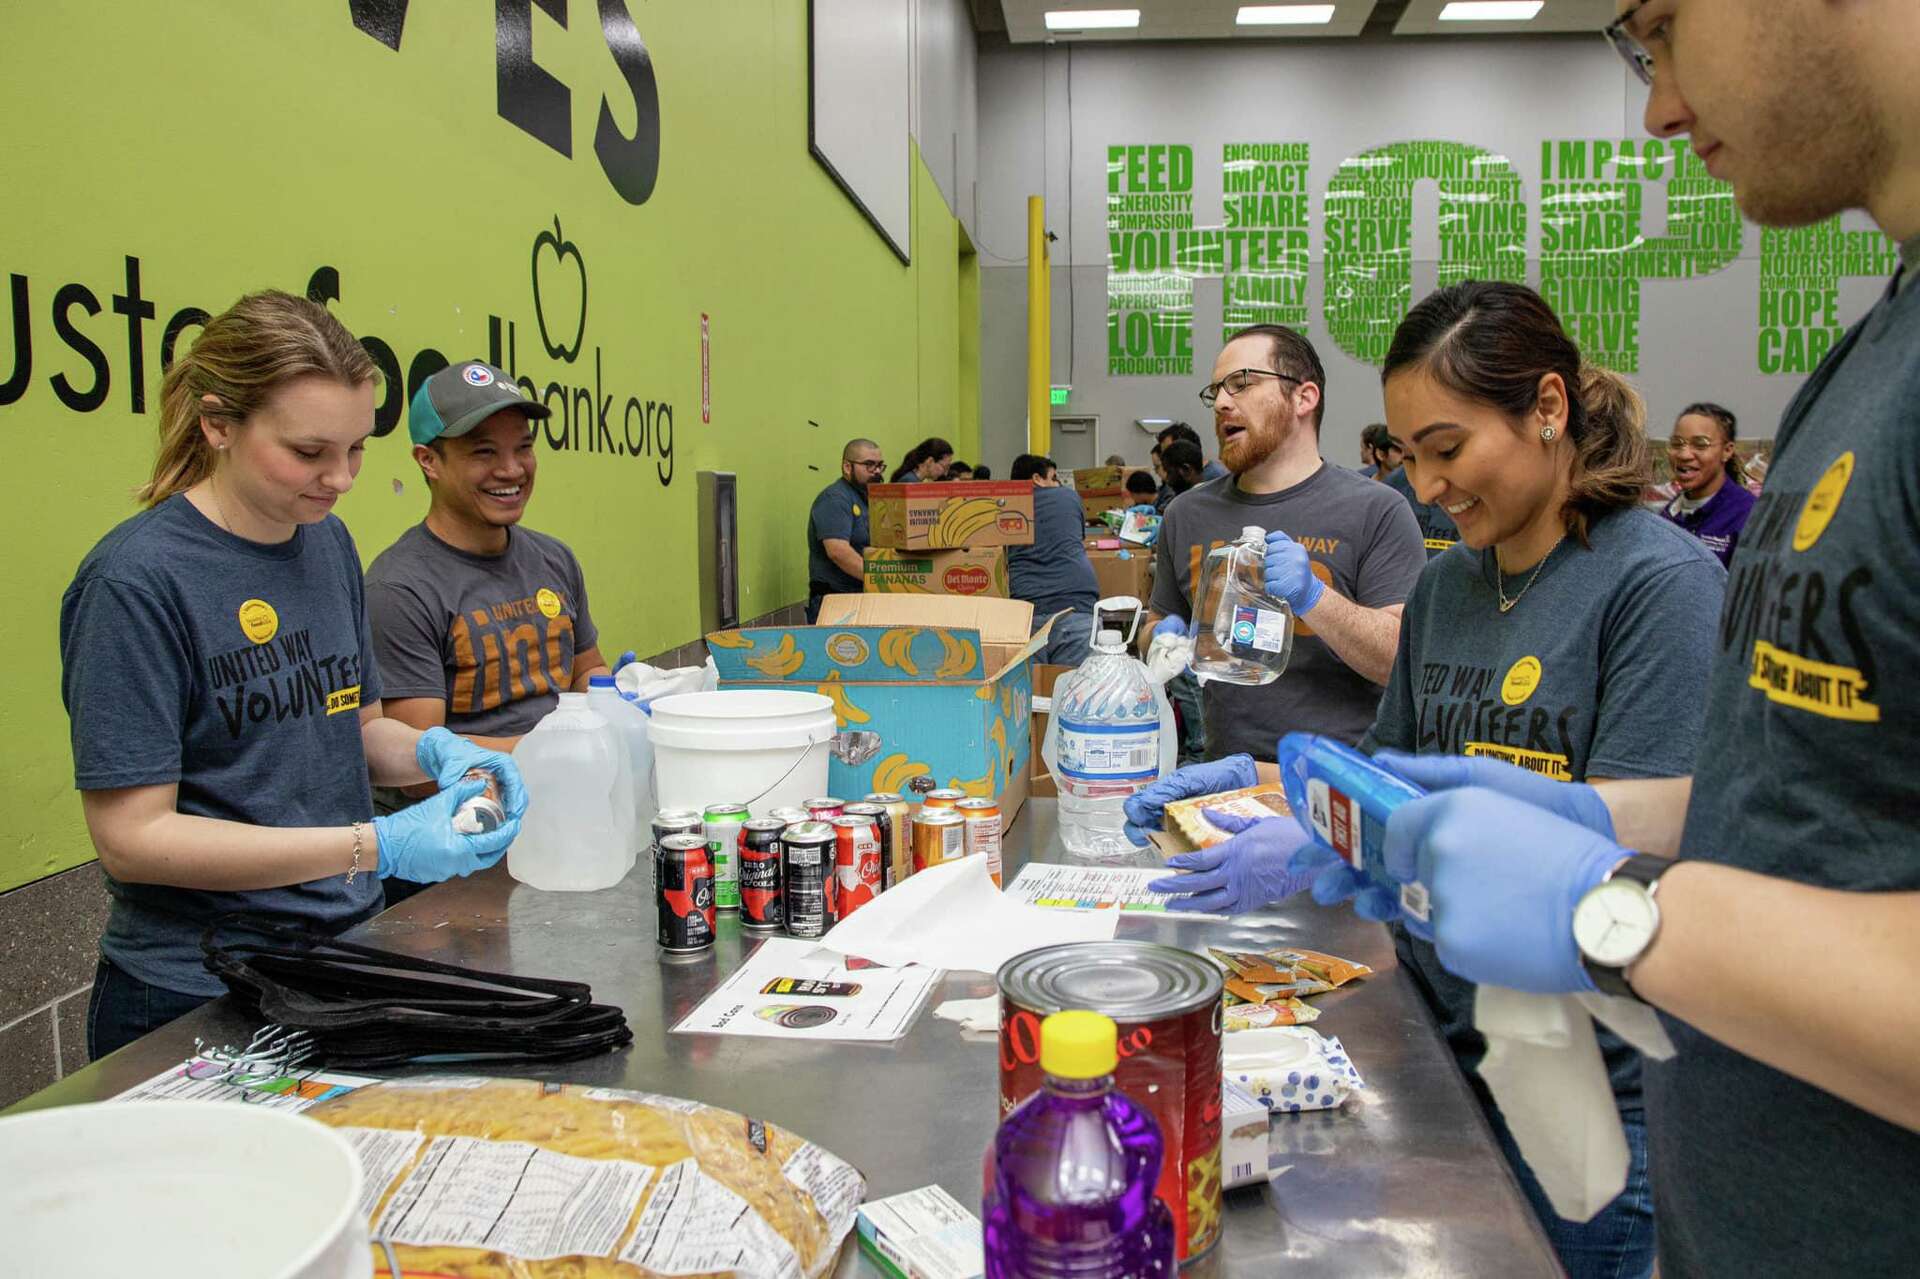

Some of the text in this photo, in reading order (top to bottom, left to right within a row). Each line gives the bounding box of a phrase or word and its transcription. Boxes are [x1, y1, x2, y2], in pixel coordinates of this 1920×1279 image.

[1223, 144, 1309, 162] ENCOURAGE
[1357, 152, 1489, 180] COMMUNITY
[1541, 140, 1689, 179] IMPACT
[1108, 145, 1193, 192] FEED
[1223, 165, 1309, 193] IMPACT
[1328, 180, 1413, 198] GENEROSITY
[1439, 180, 1521, 201] SUPPORT
[1540, 183, 1641, 212] BLESSED
[1668, 178, 1735, 197] OUTREAC
[1108, 194, 1193, 212] GENEROSITY
[1223, 194, 1309, 228] SHARE
[1324, 198, 1412, 218] OUTREACH
[1108, 213, 1193, 230] COMPASSION
[1439, 202, 1527, 233] GIVING
[1324, 218, 1412, 253] SERVE
[1540, 212, 1641, 251] SHARE
[1691, 224, 1742, 250] LOVE
[1760, 231, 1895, 254] GENEROSITY
[1108, 231, 1309, 273] VOLUNTEER
[1439, 233, 1526, 260] THANKS
[1324, 253, 1411, 281] INSPIRE
[1540, 251, 1693, 278] NOURISHMENT
[1760, 253, 1897, 276] NOURISHMENT
[1223, 275, 1308, 306] FAMILY
[1541, 279, 1640, 313] GIVING
[1761, 277, 1837, 289] COMMITMENT
[1324, 297, 1409, 320] CONNECT
[1760, 291, 1839, 327] HOPE
[1108, 311, 1193, 357] LOVE
[1558, 313, 1639, 351] ERVE
[1108, 357, 1193, 375] PRODUCTIVE
[1297, 536, 1340, 555] WAY
[869, 562, 918, 573] Premium
[869, 573, 927, 585] BANANAS
[491, 596, 541, 622] UNITE
[208, 630, 314, 690] UNITED WAY
[1451, 665, 1497, 702] WAY
[1517, 755, 1549, 776] ABOUT
[1551, 760, 1563, 776] IT
